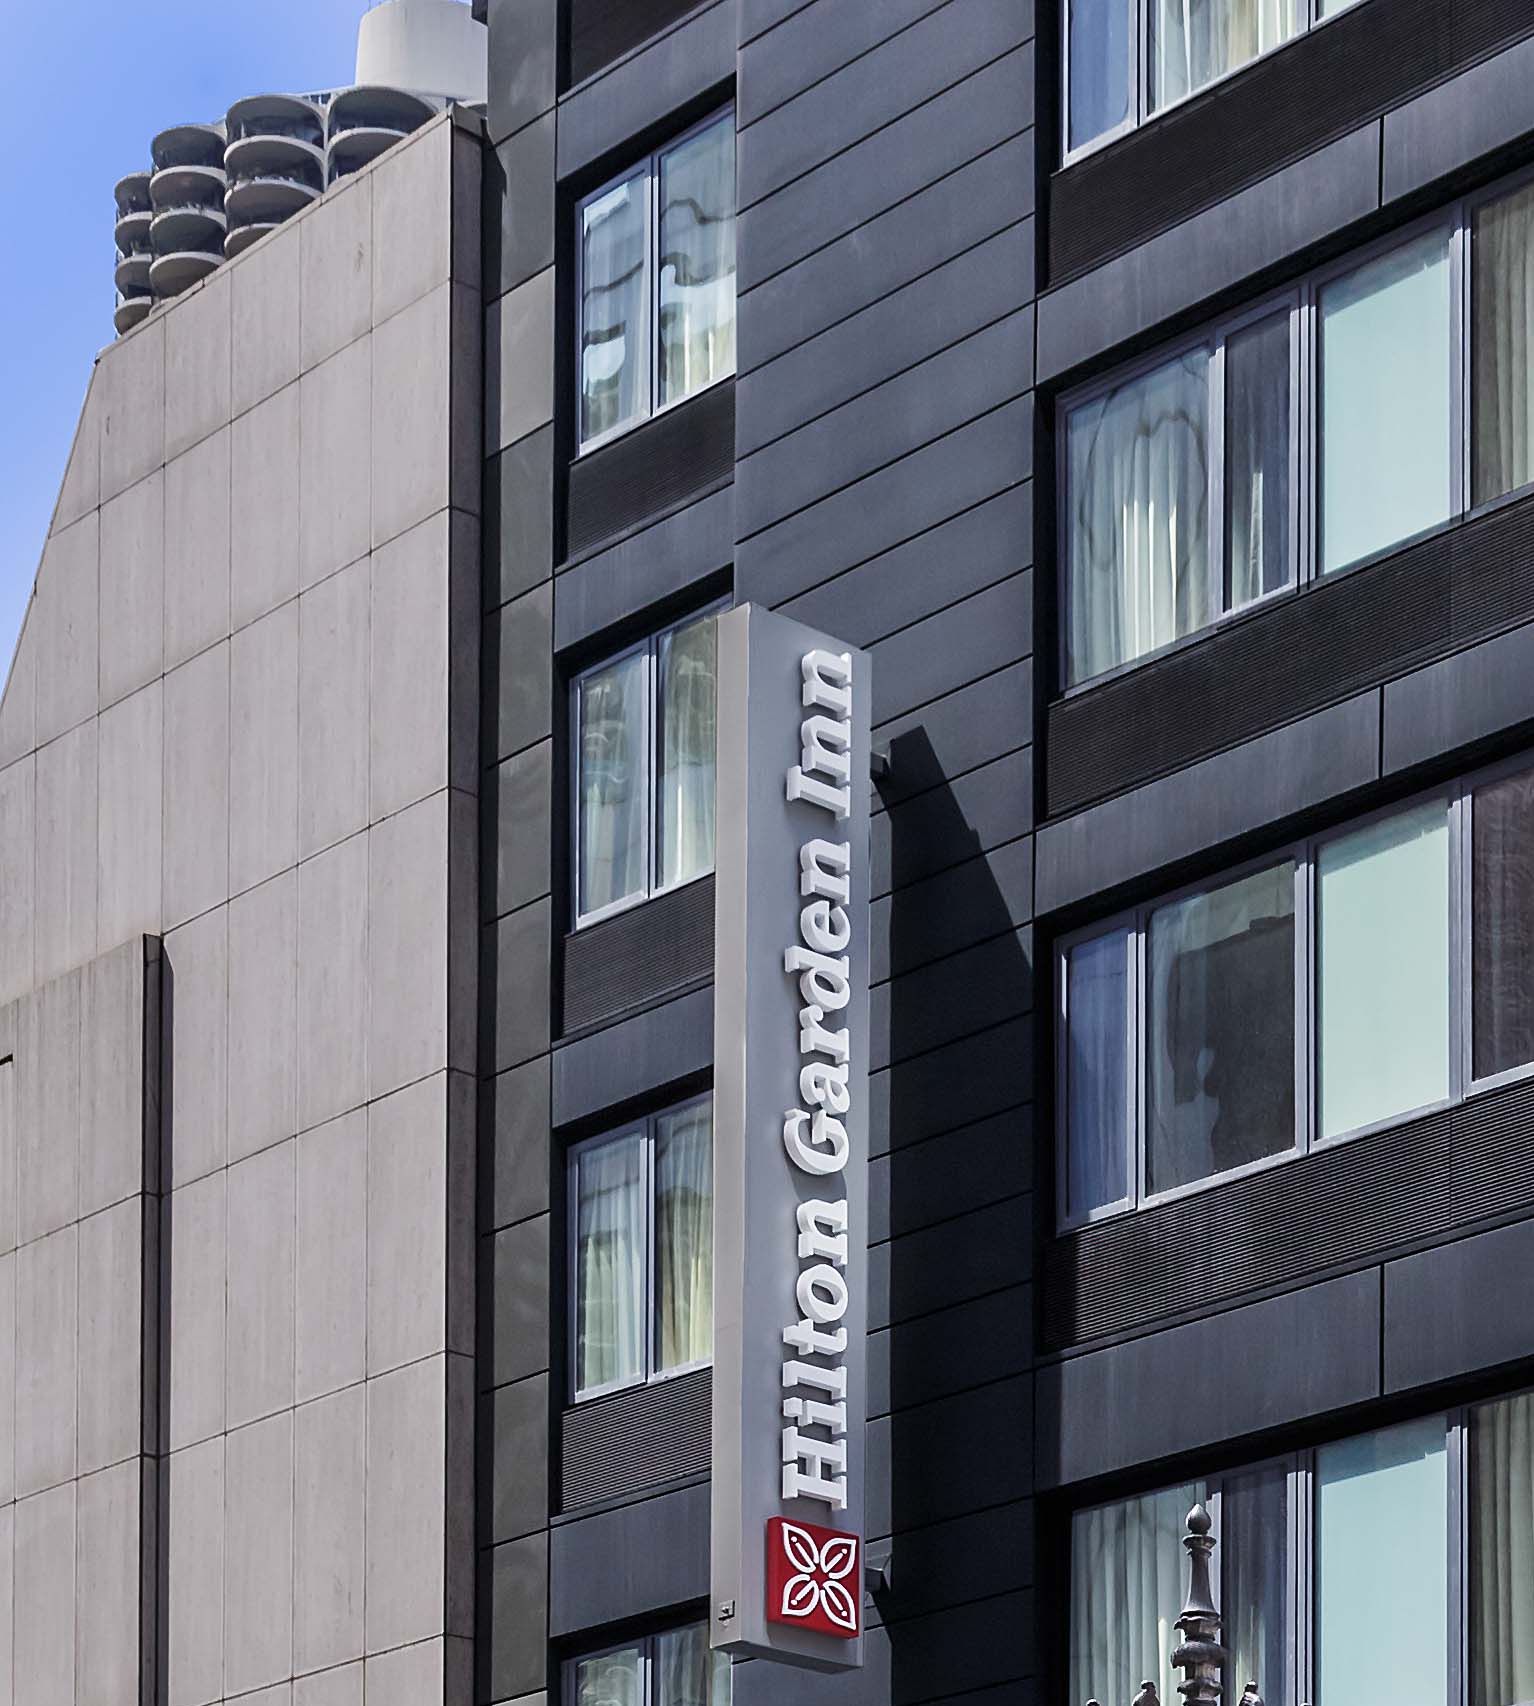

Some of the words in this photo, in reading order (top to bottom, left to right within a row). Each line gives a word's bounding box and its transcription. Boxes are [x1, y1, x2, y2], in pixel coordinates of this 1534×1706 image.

[786, 650, 852, 821] Inn
[784, 839, 851, 1175] Garden
[782, 1198, 848, 1510] Hilton
